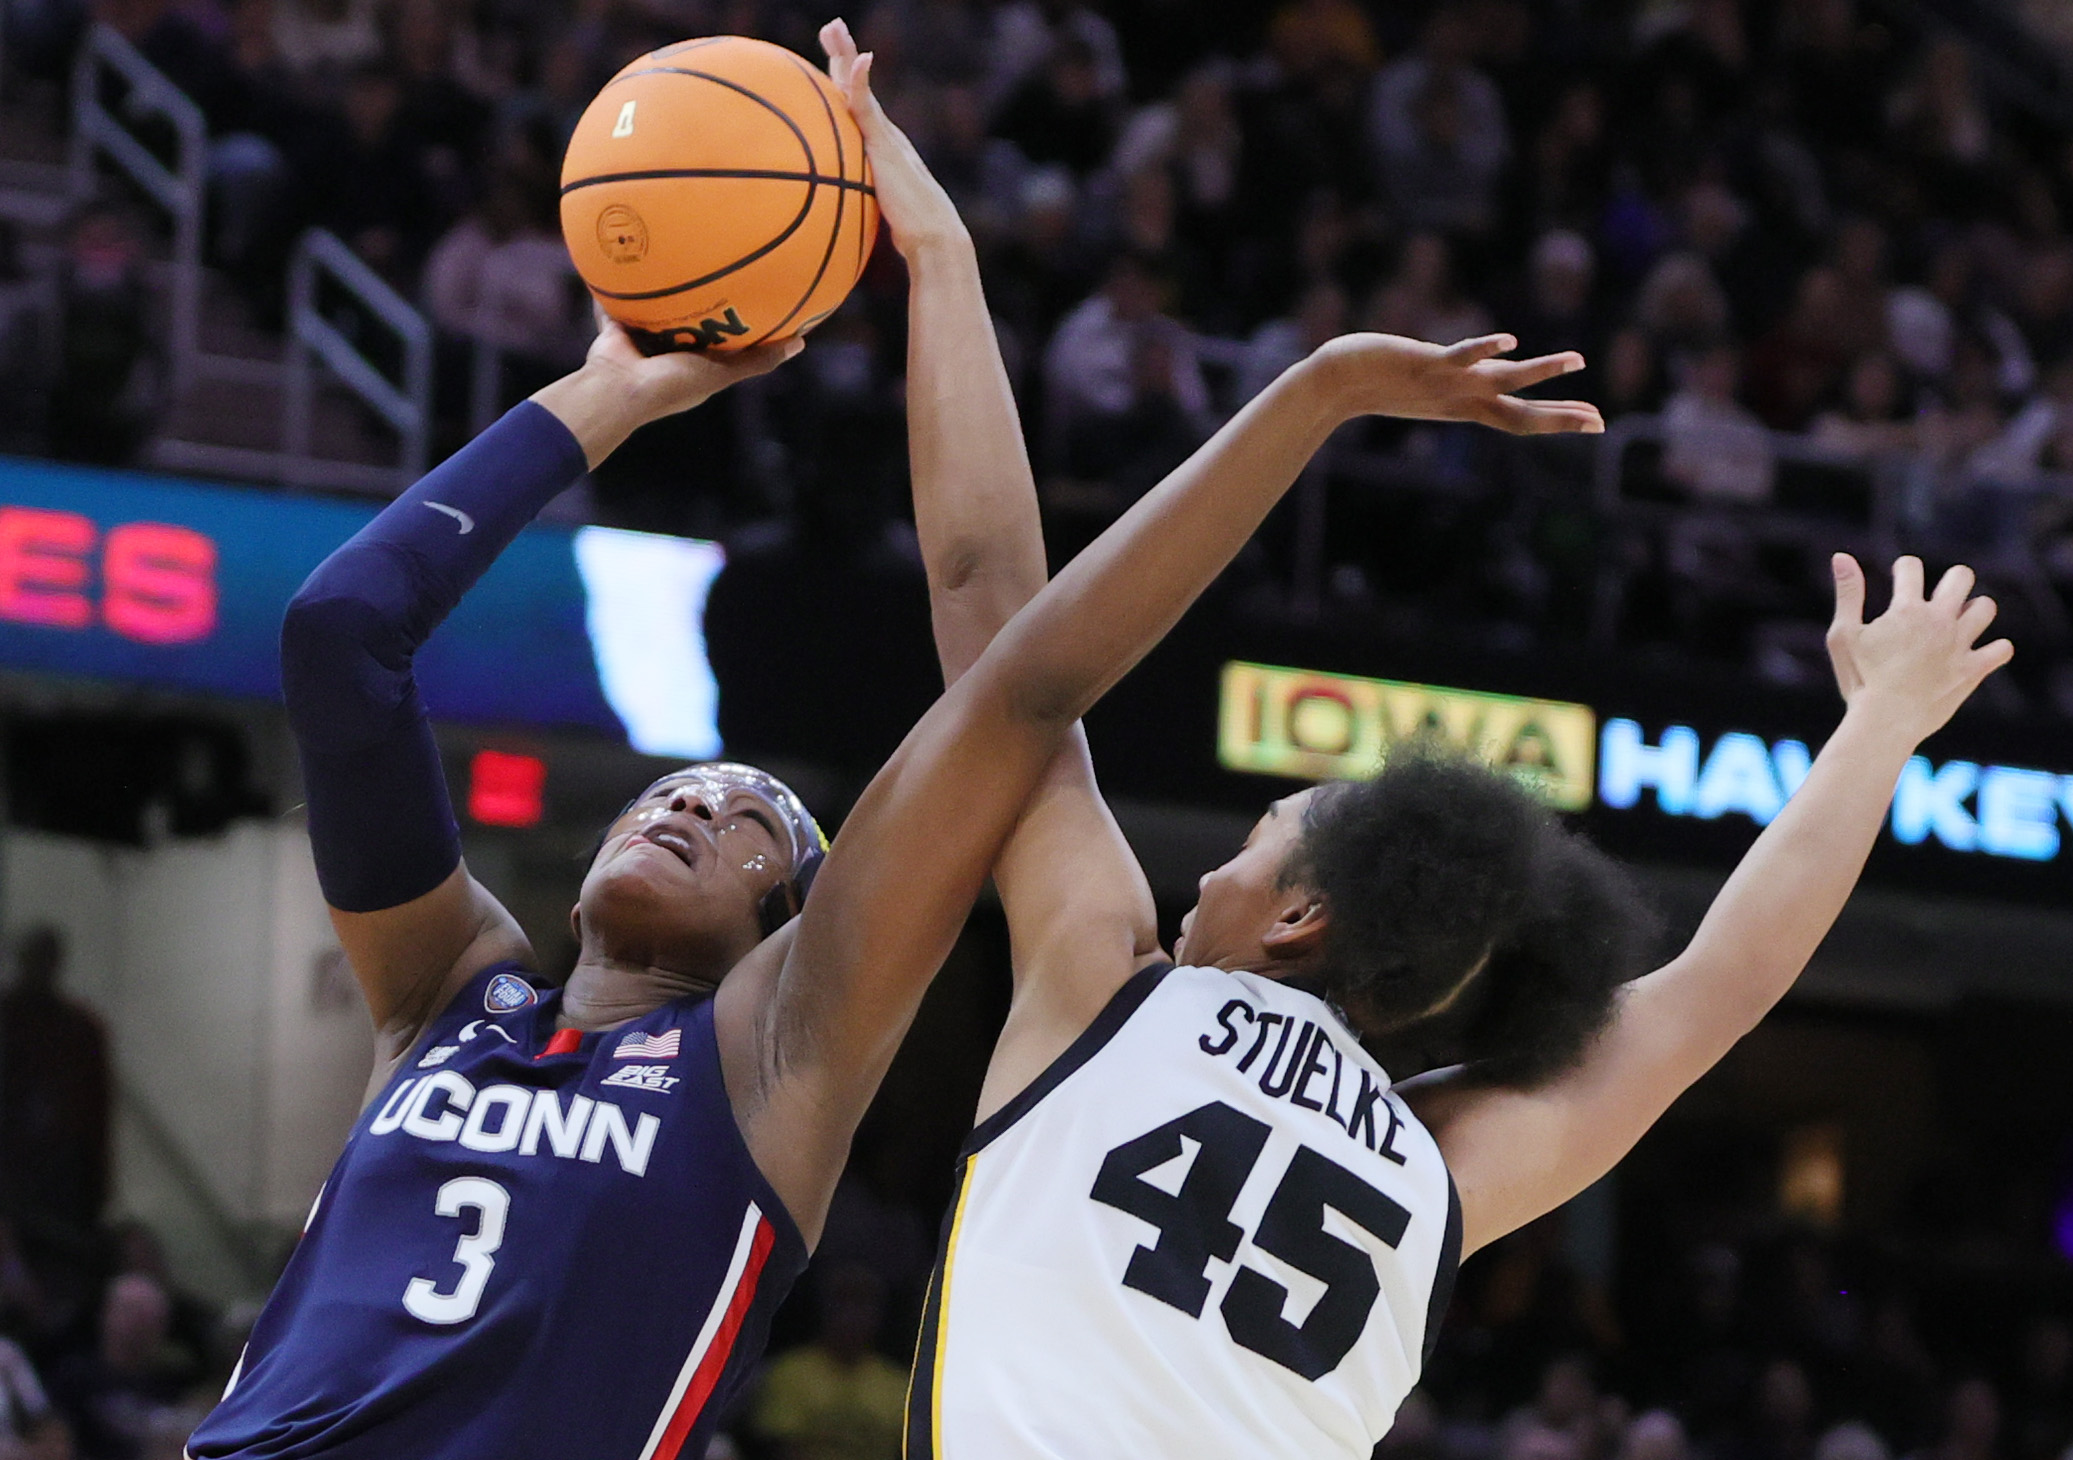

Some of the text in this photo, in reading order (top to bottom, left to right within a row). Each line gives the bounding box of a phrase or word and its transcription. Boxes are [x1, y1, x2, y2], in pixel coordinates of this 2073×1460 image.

[369, 1069, 661, 1177] UCONN
[606, 1074, 680, 1089] EAST
[618, 1065, 670, 1078] BIG
[1198, 999, 1408, 1167] STUELKE
[402, 1176, 512, 1325] 3
[1089, 1100, 1412, 1383] 45
